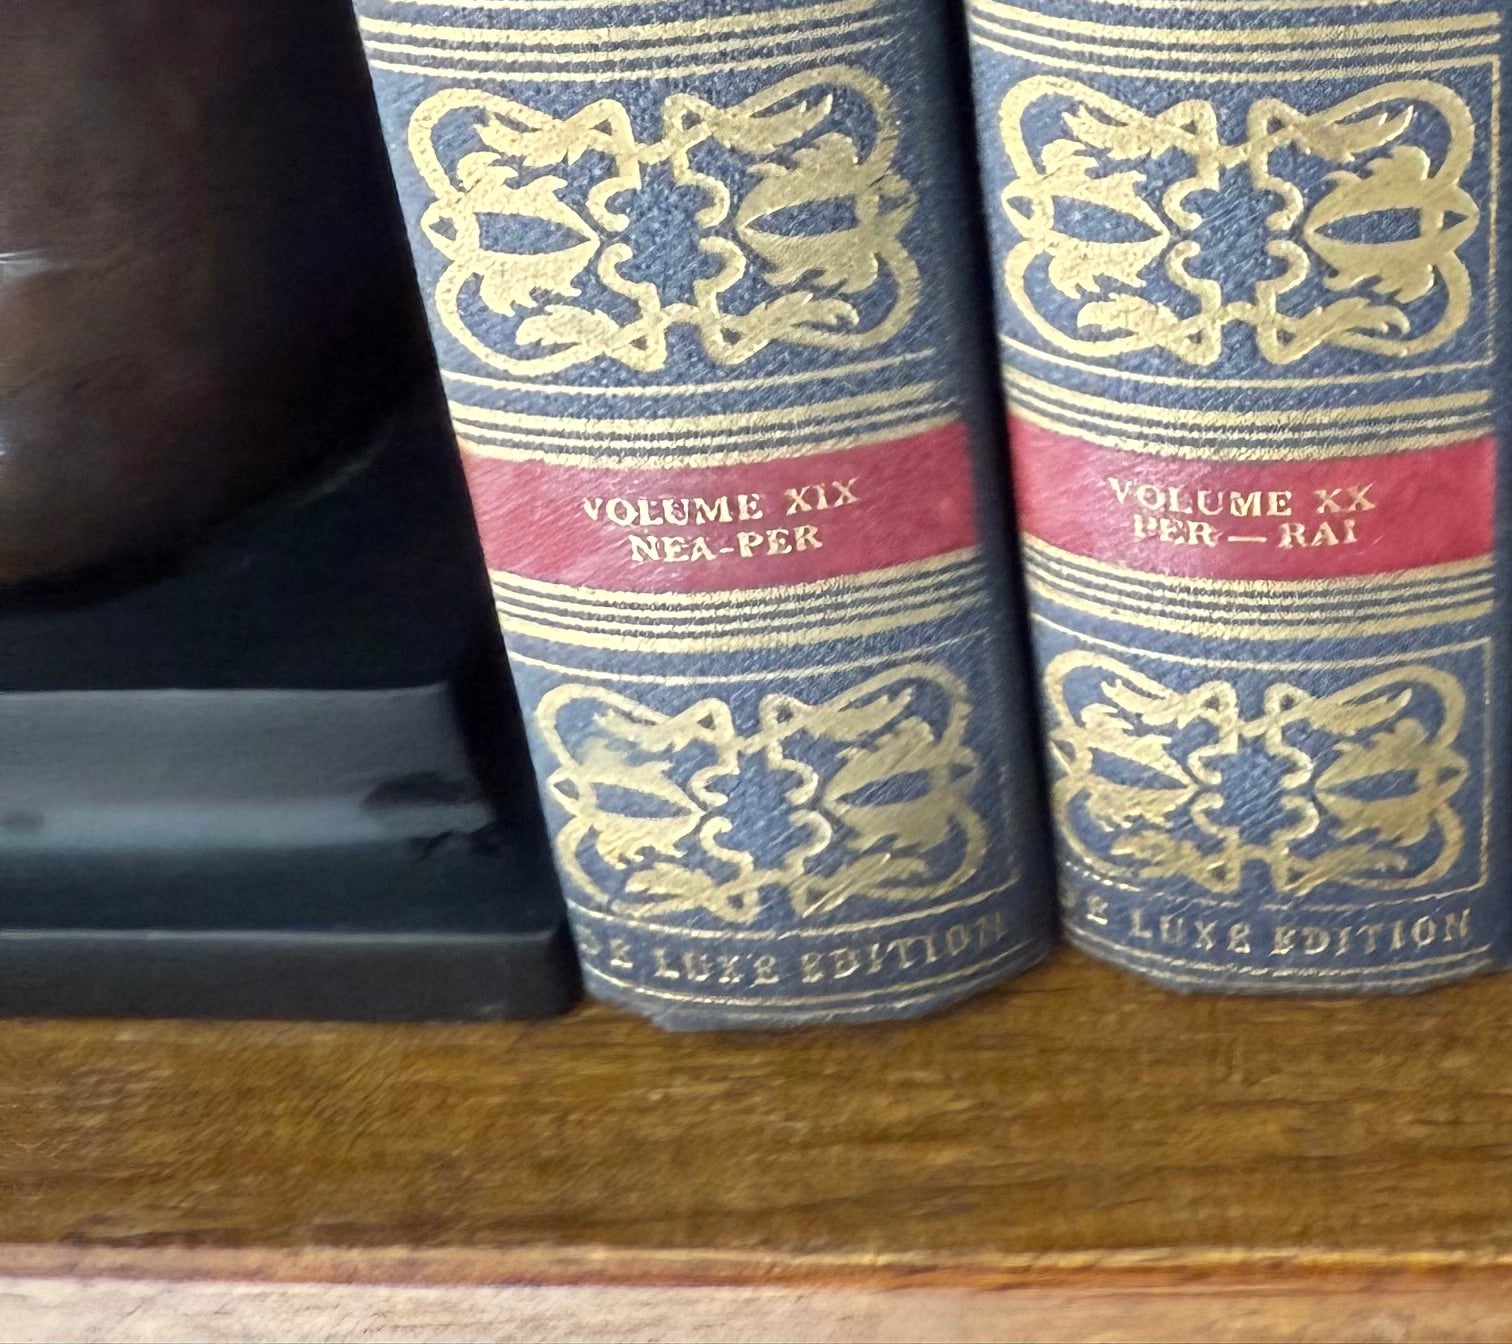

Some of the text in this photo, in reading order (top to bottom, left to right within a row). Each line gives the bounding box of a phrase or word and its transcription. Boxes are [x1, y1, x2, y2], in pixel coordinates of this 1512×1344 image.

[582, 475, 860, 527] VOLUME XIX
[1107, 477, 1377, 517] VOLUME XX
[627, 524, 823, 563] NEA-PER
[1129, 908, 1251, 955] LUXE
[1269, 908, 1472, 957] EDITION
